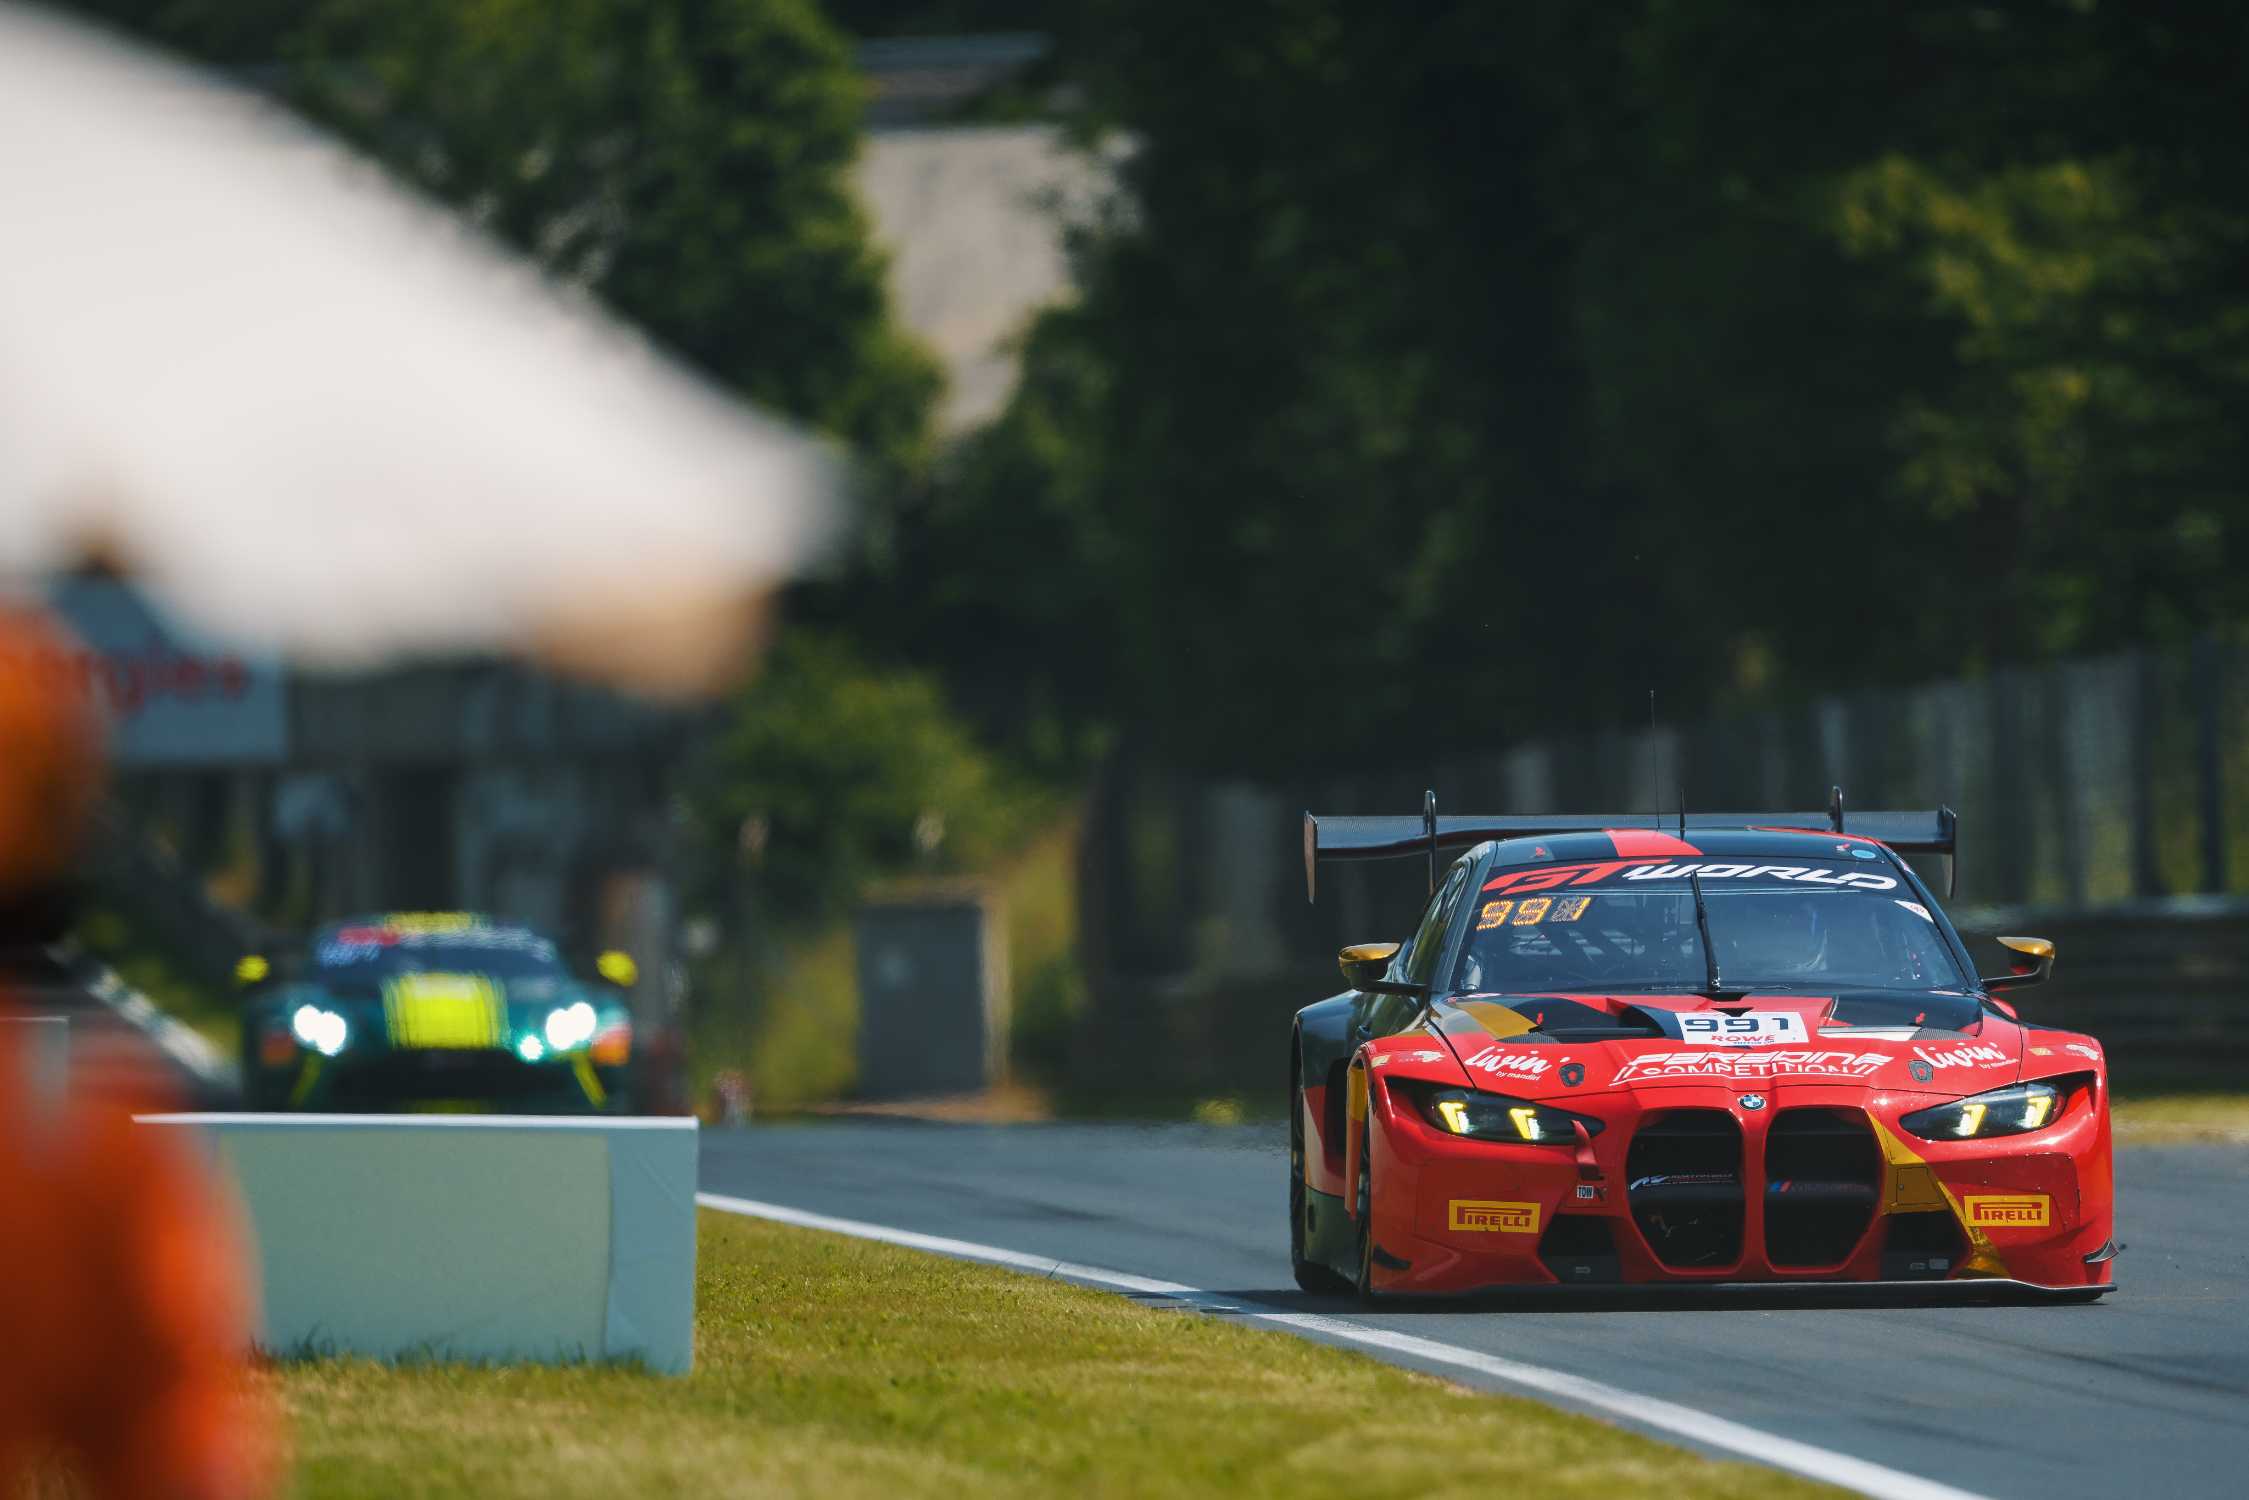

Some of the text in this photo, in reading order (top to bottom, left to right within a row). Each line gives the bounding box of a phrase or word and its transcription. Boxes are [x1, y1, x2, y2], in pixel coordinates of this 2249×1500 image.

[1481, 858, 1898, 896] GT WORLD
[1684, 1017, 1789, 1033] 991
[1711, 1034, 1776, 1042] ROWE
[1456, 1206, 1533, 1227] PIRELLI
[1973, 1202, 2043, 1220] PIRELLI
